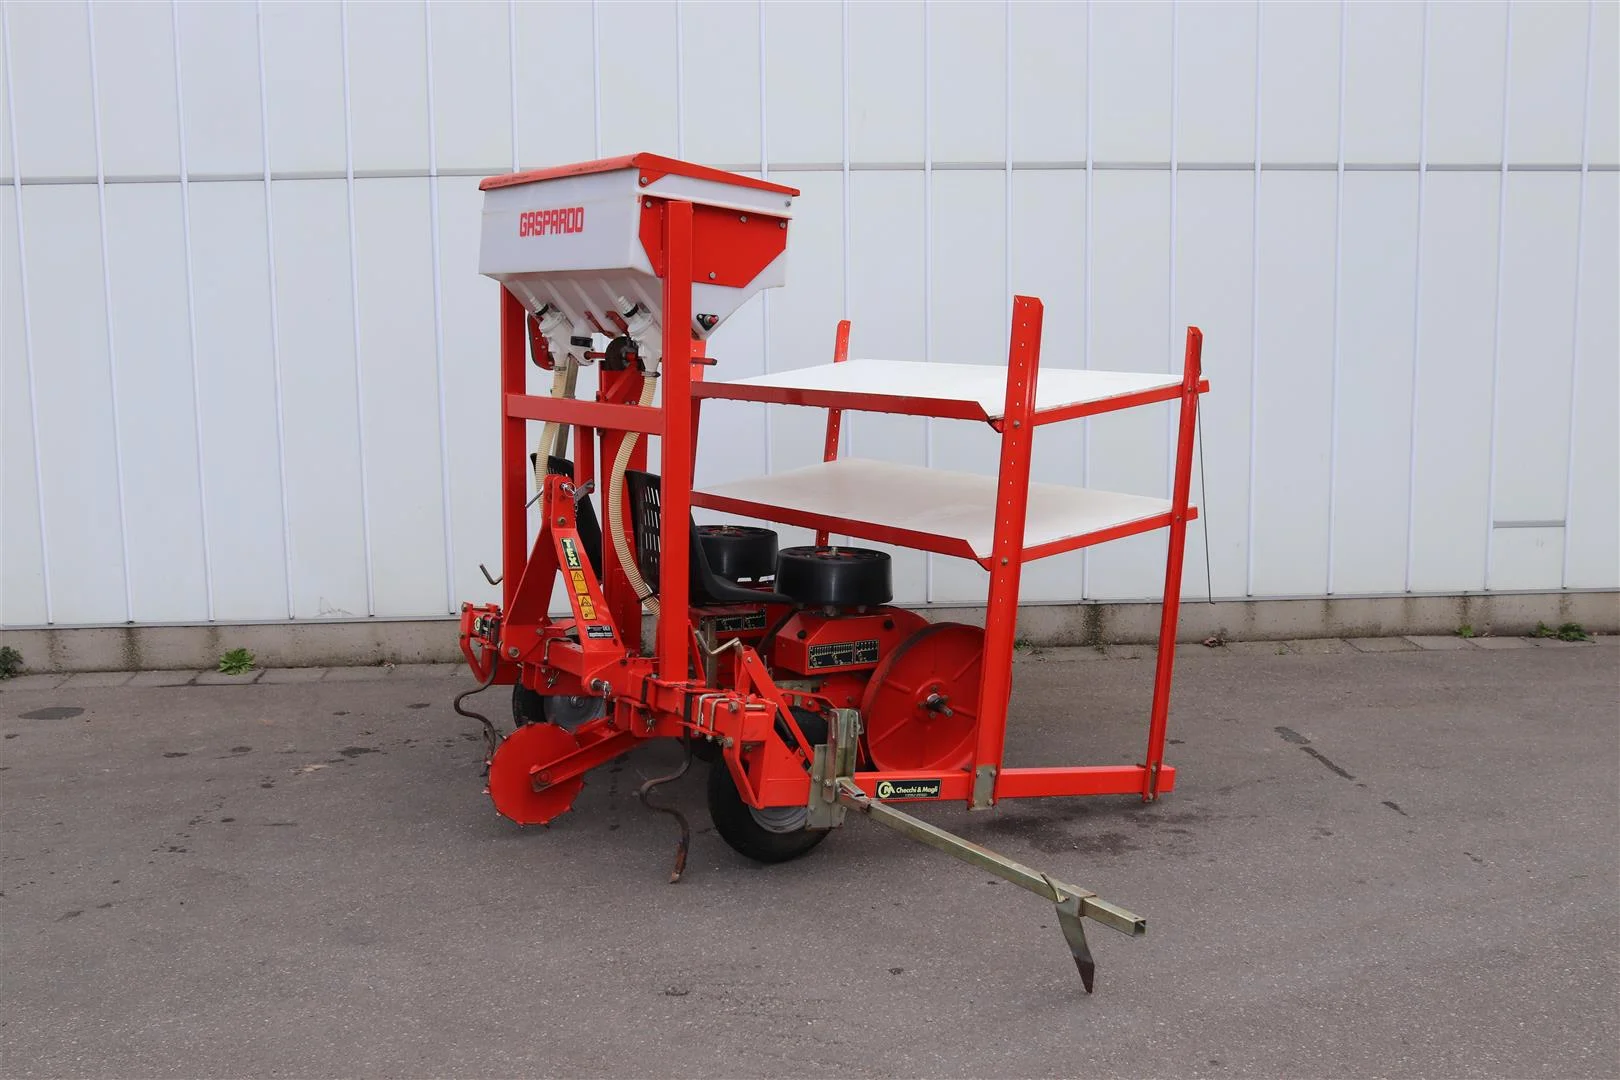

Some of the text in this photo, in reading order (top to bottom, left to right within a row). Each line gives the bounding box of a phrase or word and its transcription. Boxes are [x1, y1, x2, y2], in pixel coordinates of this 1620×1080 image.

[520, 207, 584, 237] GASPARDO
[563, 539, 579, 567] TEX
[896, 786, 917, 794] Checchi
[922, 785, 938, 794] Magli
